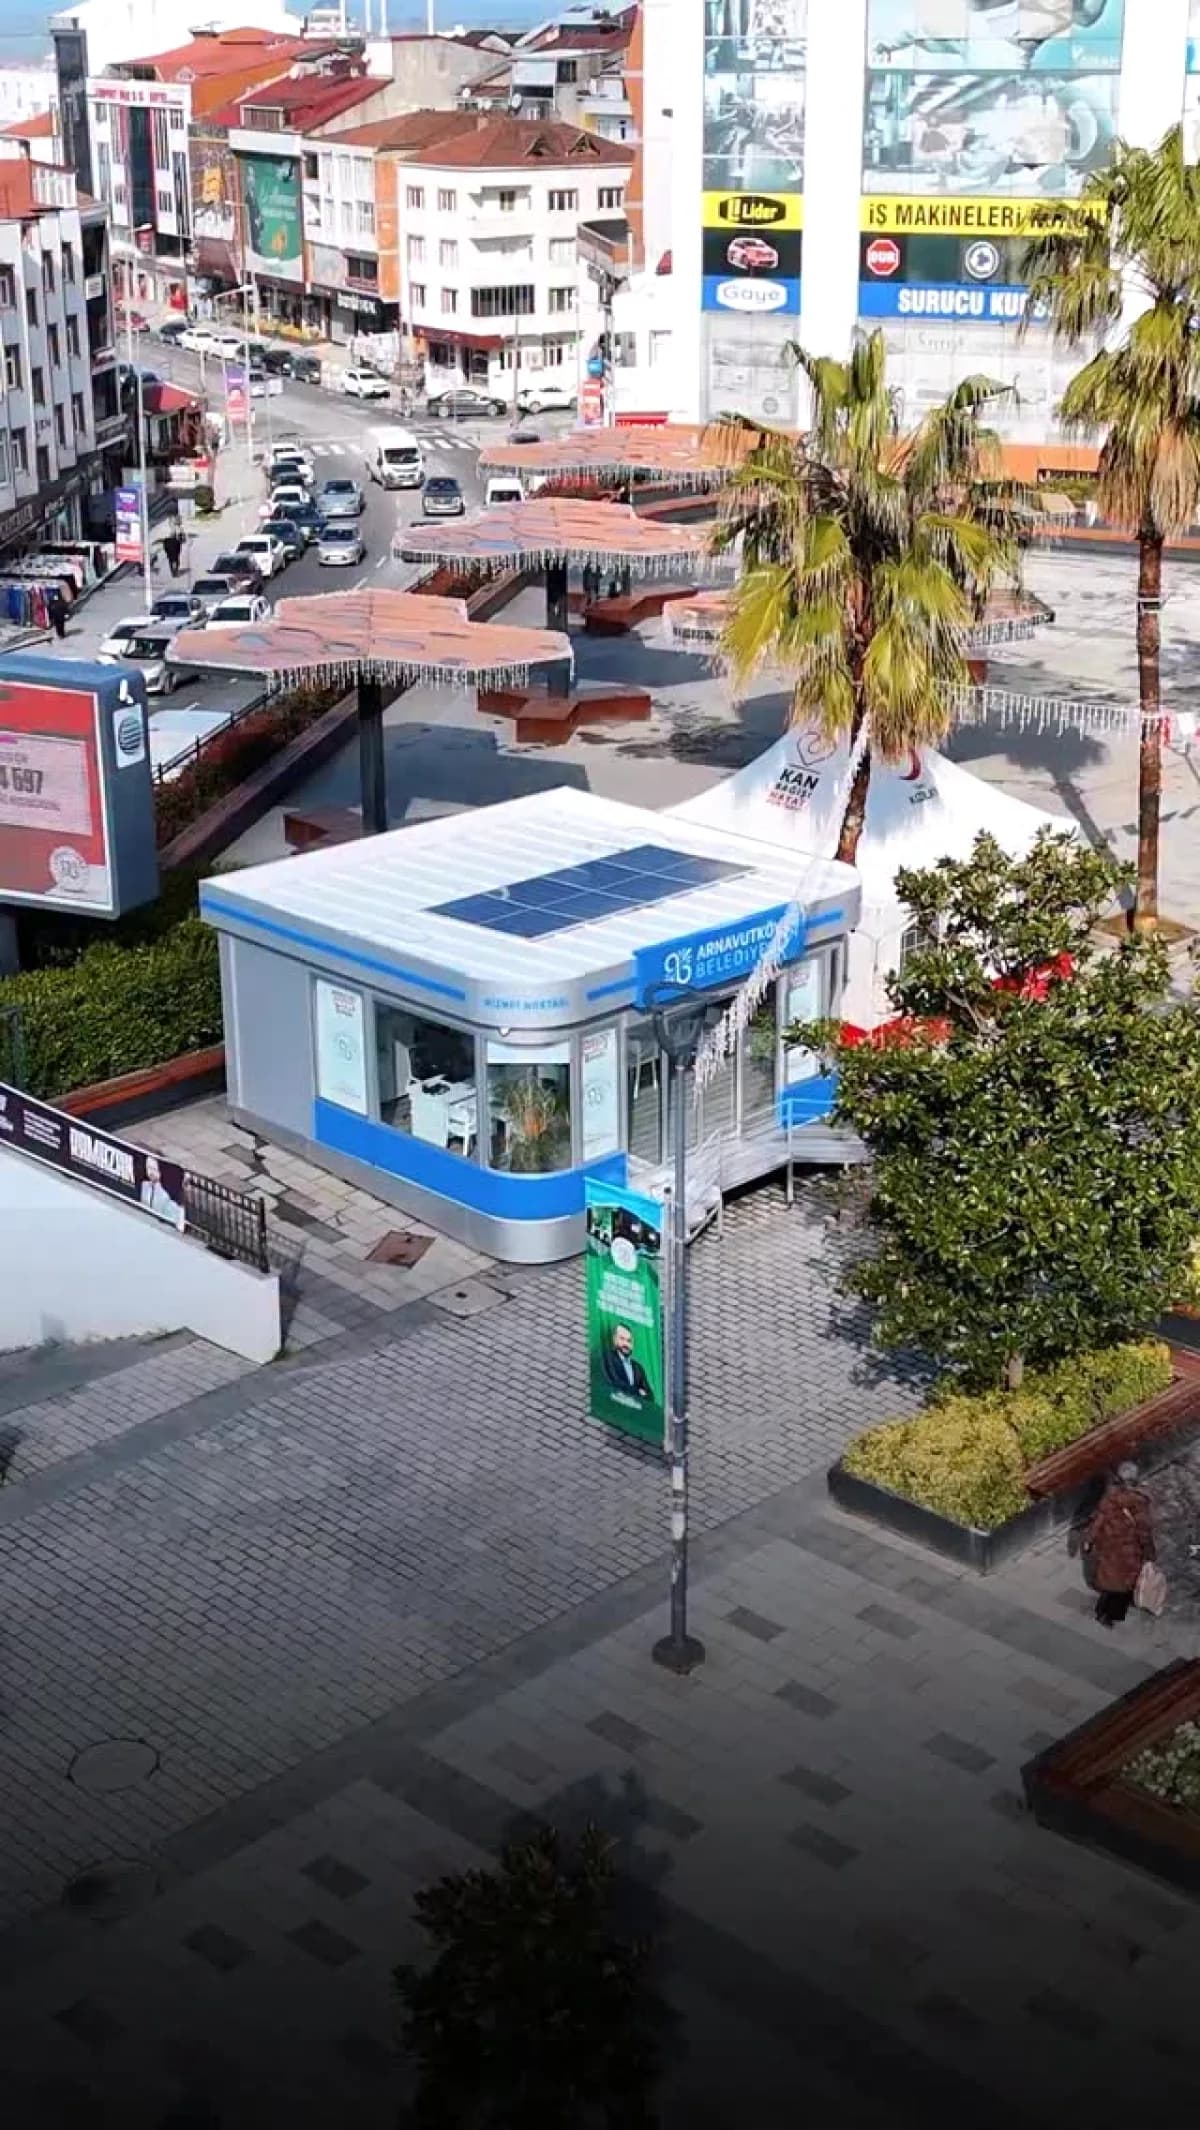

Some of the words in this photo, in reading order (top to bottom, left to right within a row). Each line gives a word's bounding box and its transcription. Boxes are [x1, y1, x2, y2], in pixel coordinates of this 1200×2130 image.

[742, 202, 778, 220] Lider
[870, 250, 896, 264] DUR
[723, 285, 780, 304] Gaye
[779, 768, 820, 789] KAN
